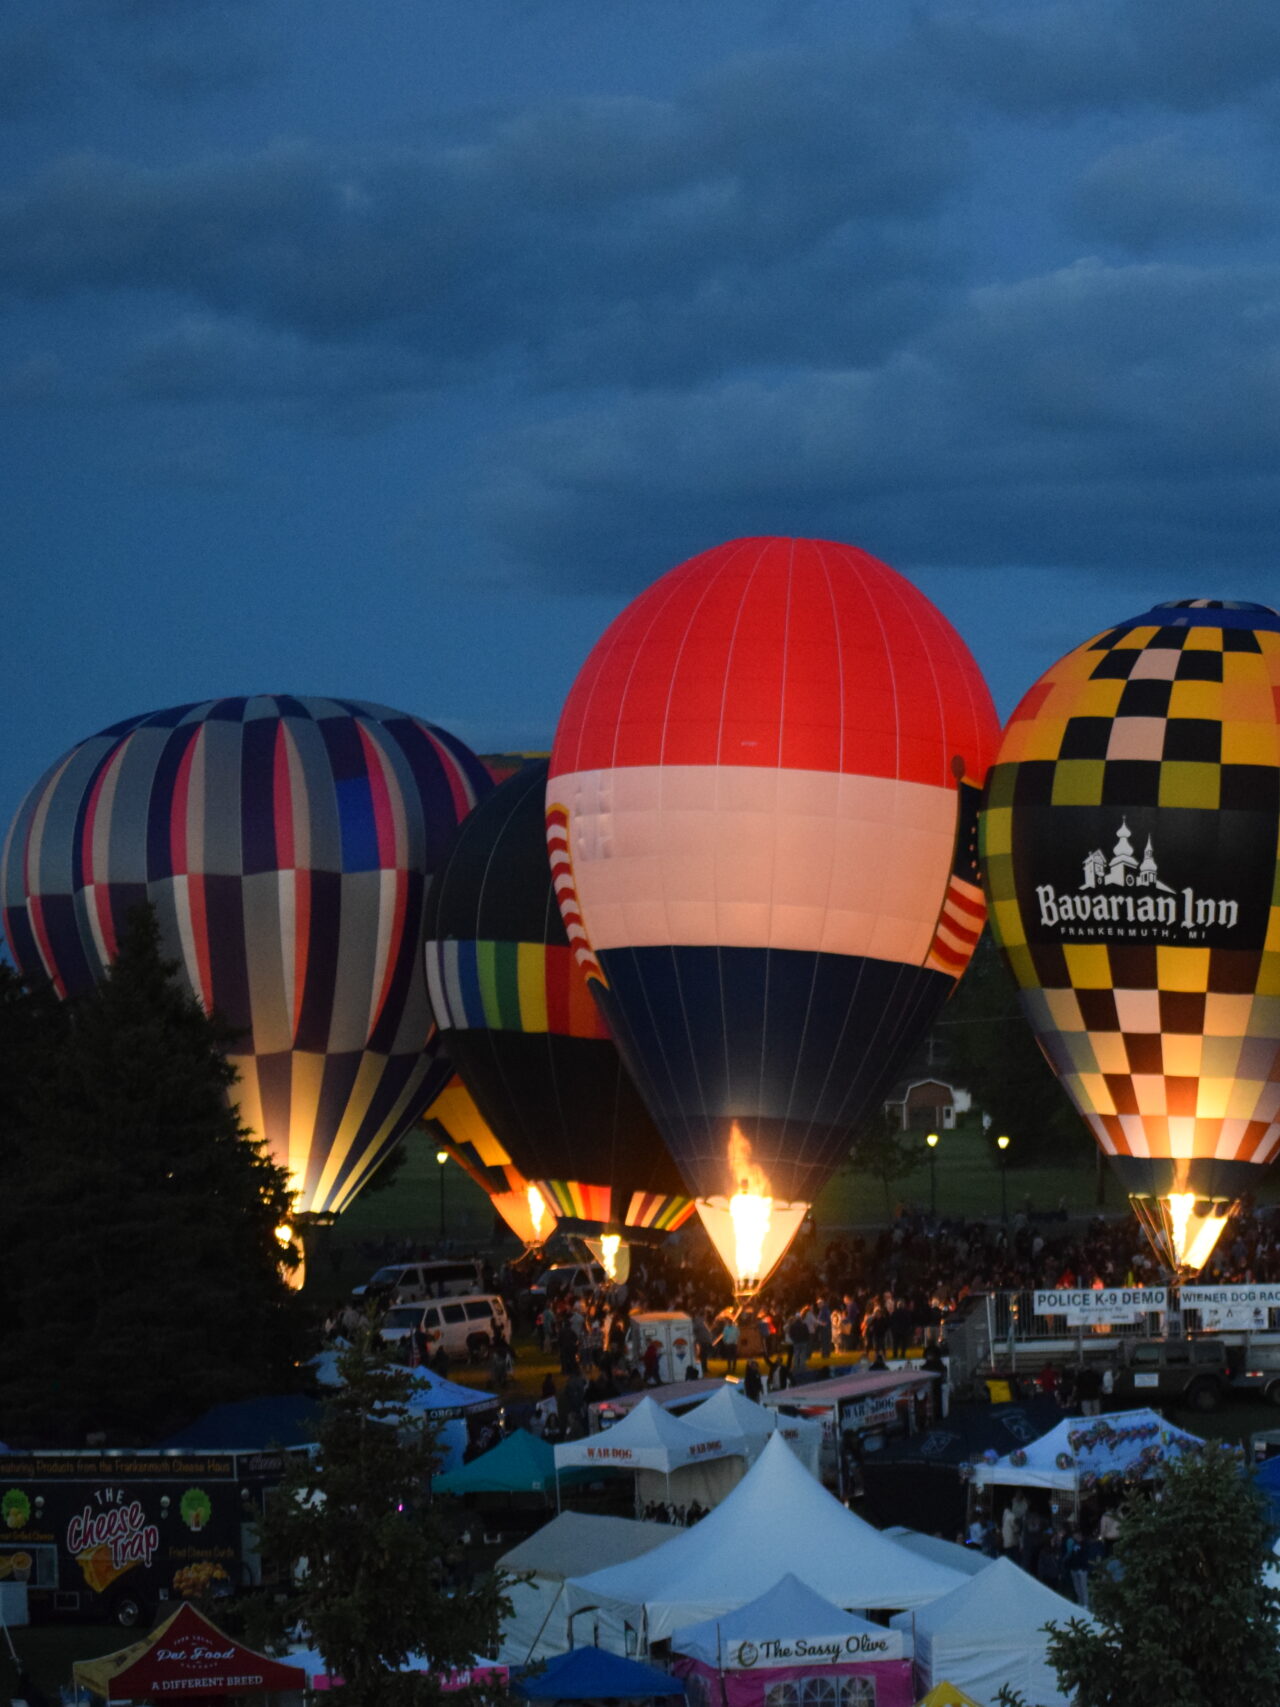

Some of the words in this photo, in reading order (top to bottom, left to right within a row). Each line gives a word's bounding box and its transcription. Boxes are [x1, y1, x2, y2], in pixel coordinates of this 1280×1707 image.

[1035, 884, 1177, 927] Bavarian
[1181, 887, 1239, 929] Inn
[1188, 931, 1206, 940] MI
[1037, 1293, 1091, 1307] POLICE
[1095, 1293, 1117, 1305] K-9
[1122, 1291, 1165, 1305] DEMO
[1182, 1292, 1227, 1303] WIENER
[1231, 1291, 1256, 1302] DOG
[94, 1488, 125, 1505] THE
[67, 1501, 145, 1553] Cheese
[107, 1525, 159, 1570] Trap
[156, 1650, 186, 1661] Pet
[190, 1647, 235, 1661] Food
[760, 1639, 792, 1658] The
[795, 1640, 842, 1663] Sassy
[846, 1634, 889, 1653] Olive
[152, 1681, 159, 1691] A
[162, 1677, 224, 1690] DIFFERENT
[226, 1675, 263, 1686] BREED
